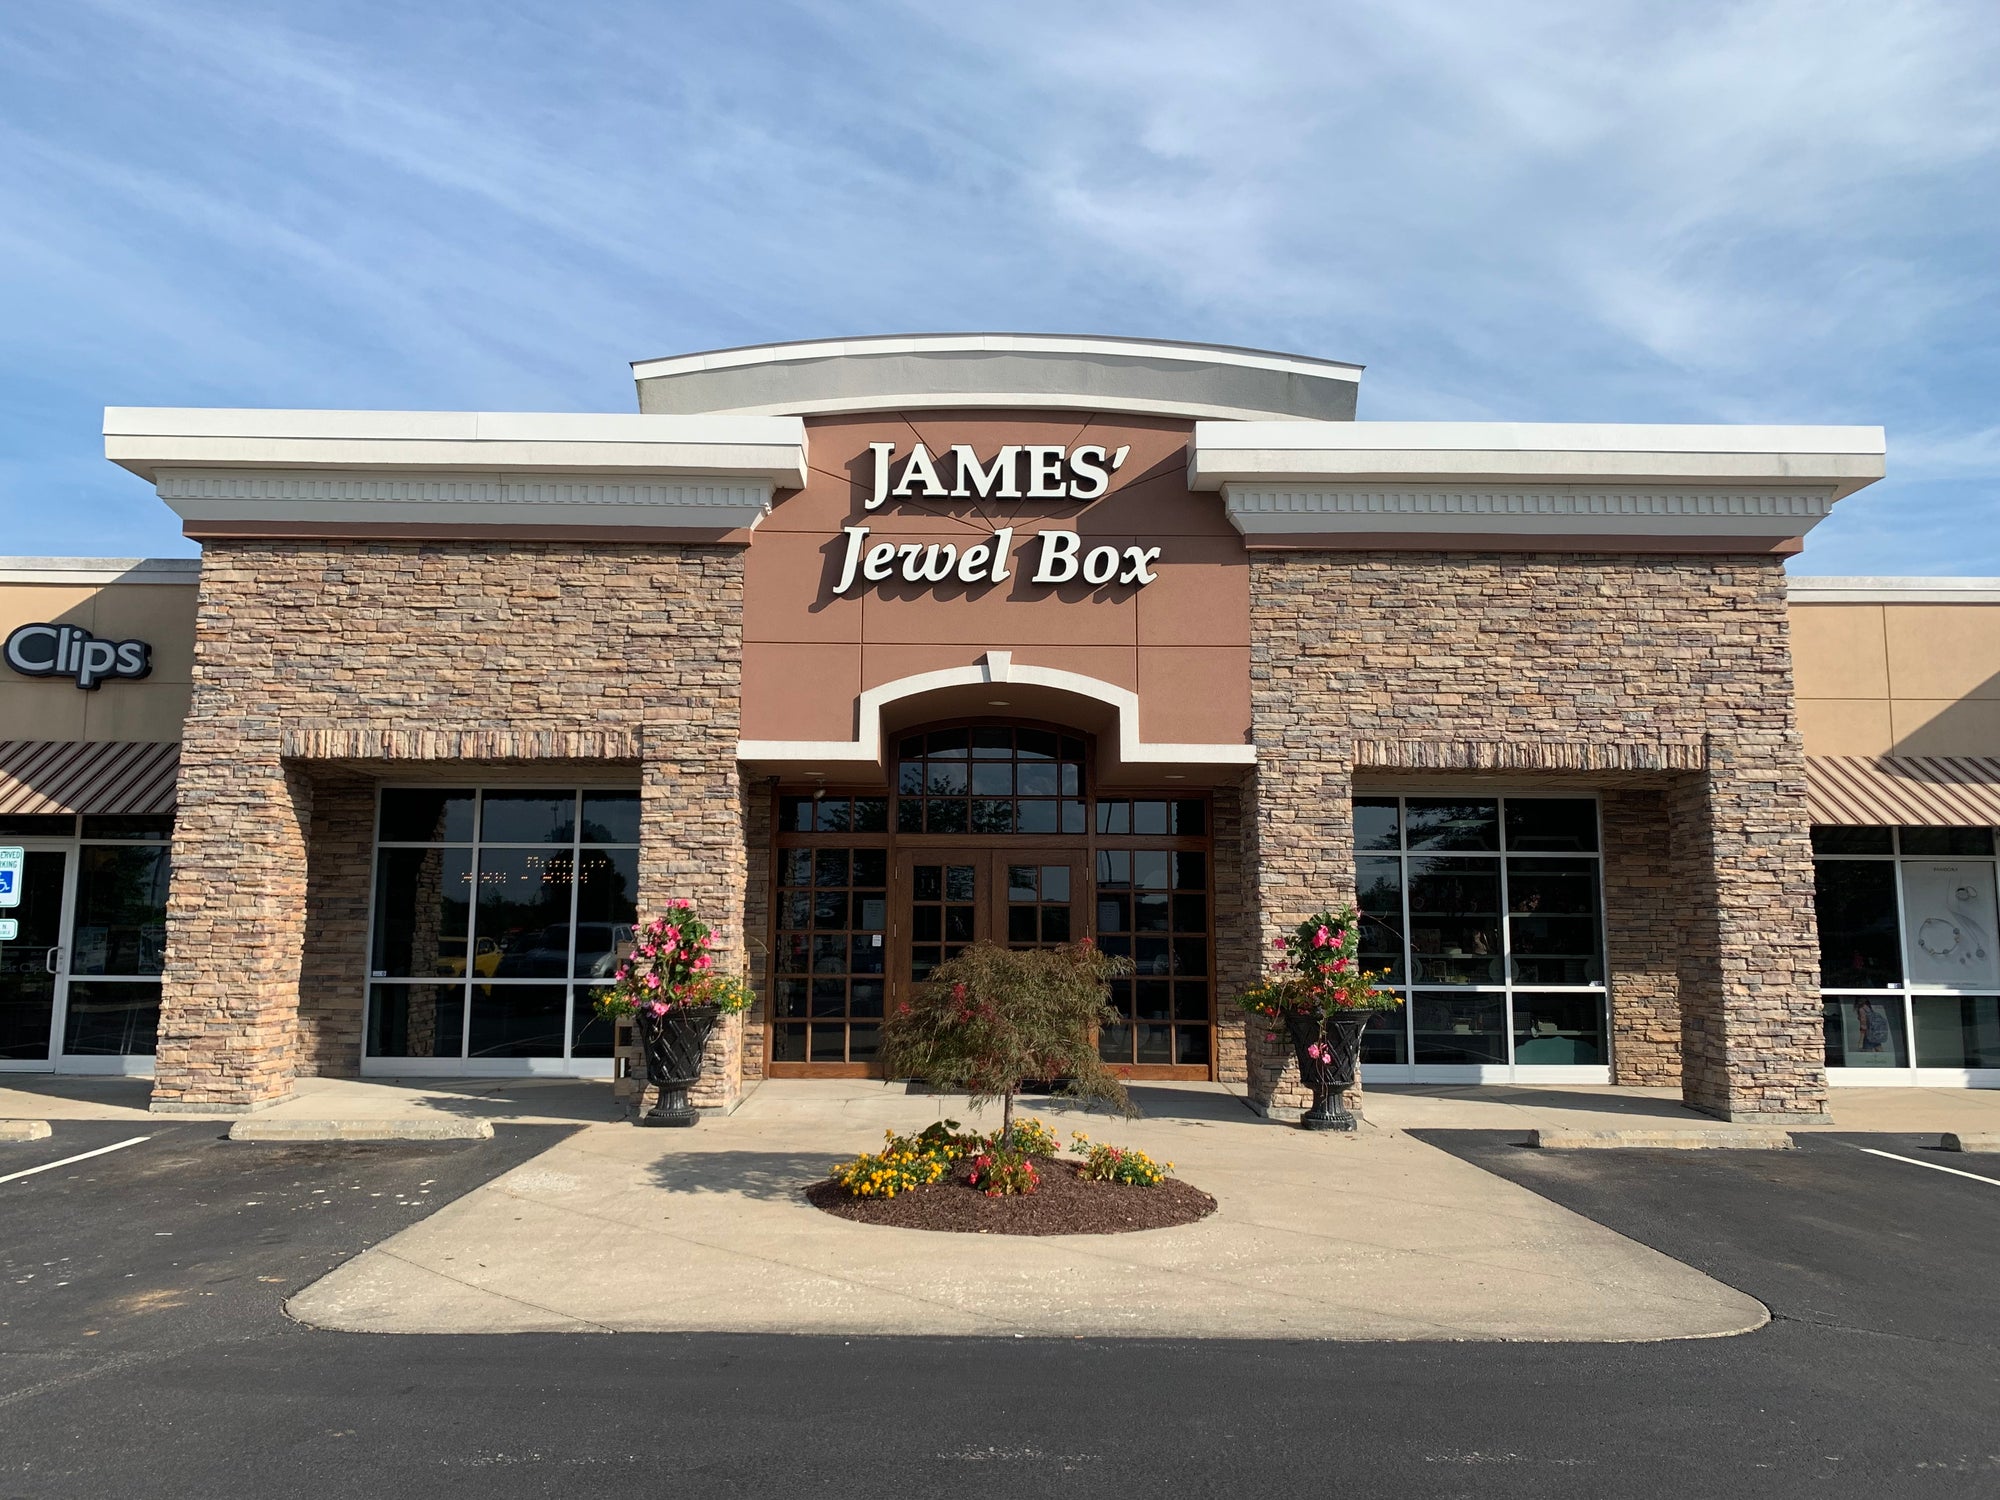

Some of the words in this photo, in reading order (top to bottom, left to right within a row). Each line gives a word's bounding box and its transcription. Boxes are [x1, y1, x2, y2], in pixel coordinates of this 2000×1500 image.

[865, 441, 1131, 511] JAMES'
[832, 526, 1015, 594] Jewel
[1031, 530, 1162, 585] Box
[8, 626, 142, 685] Clips
